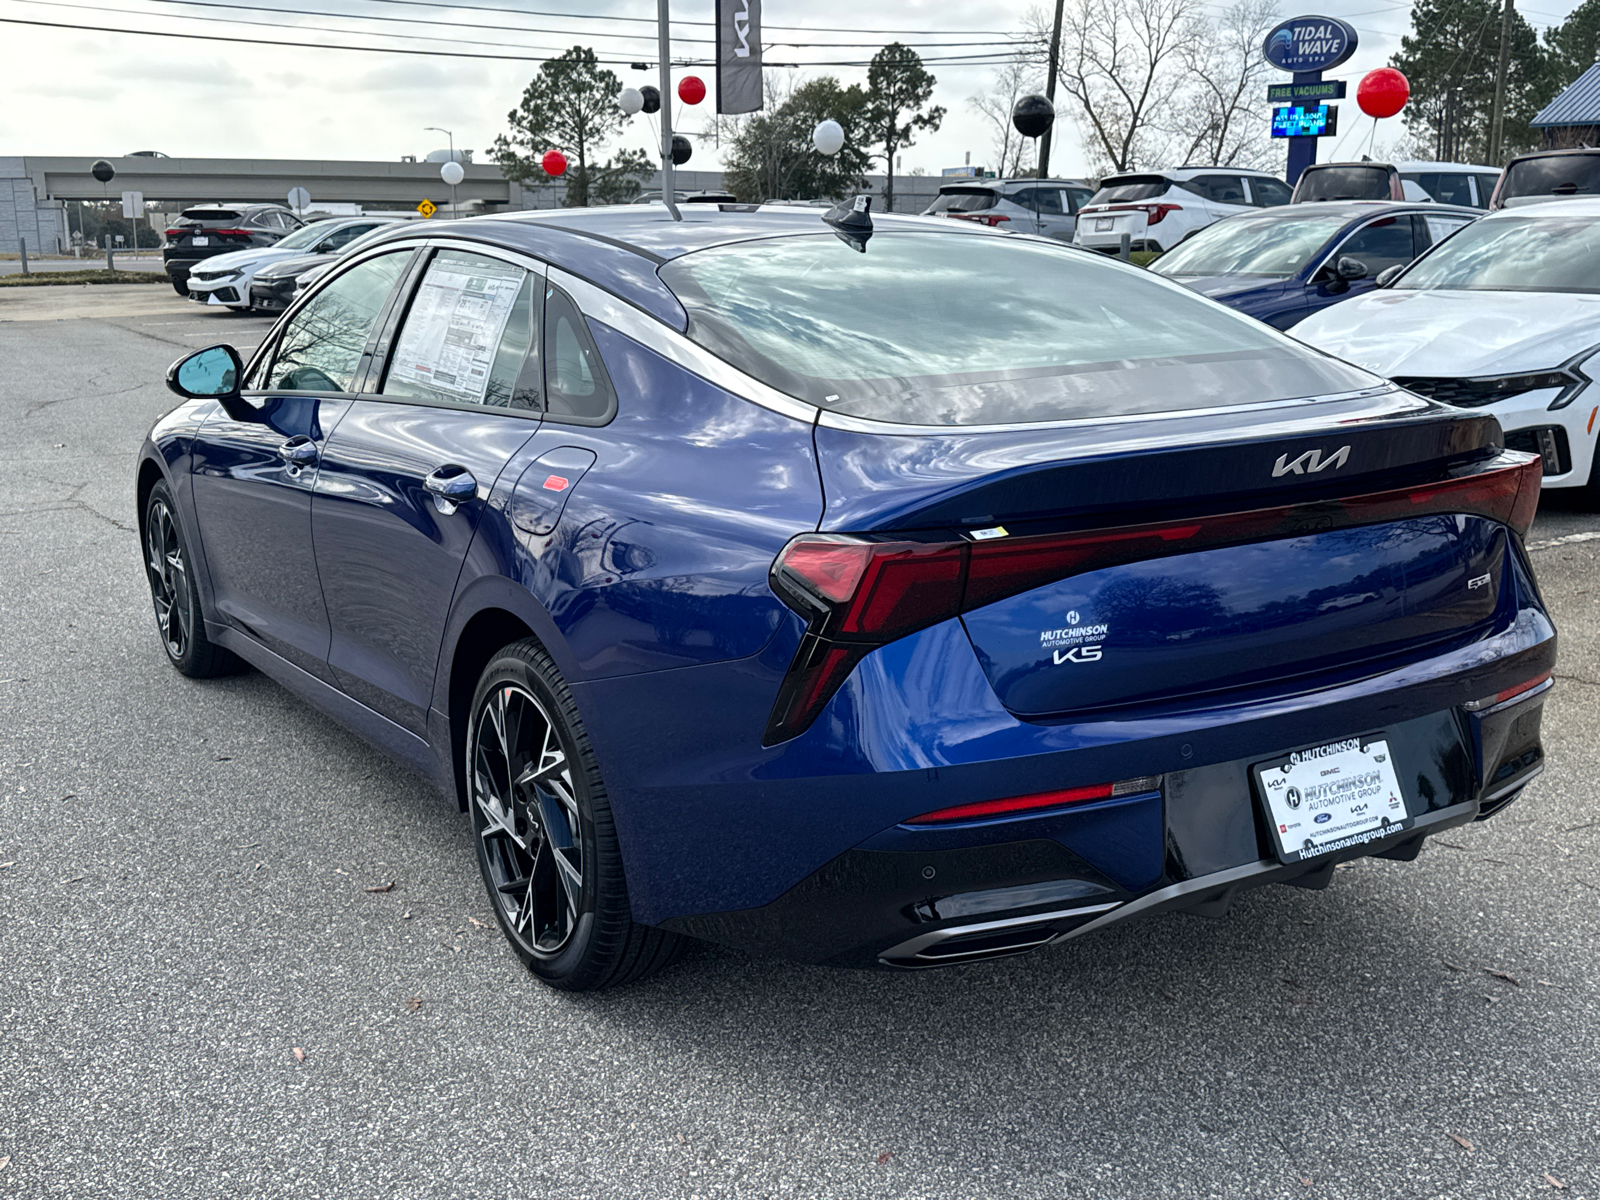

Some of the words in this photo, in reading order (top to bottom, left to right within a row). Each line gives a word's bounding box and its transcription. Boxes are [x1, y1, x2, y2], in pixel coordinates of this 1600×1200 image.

[1293, 25, 1332, 41] TIDAL
[1298, 39, 1340, 55] WAVE
[1270, 87, 1292, 98] FREE
[1294, 84, 1334, 96] VACUUMS
[1271, 445, 1351, 478] KIA
[1040, 624, 1108, 641] HUTCHINSON
[1042, 637, 1083, 648] AUTOMOTIVE
[1084, 634, 1106, 643] GROUP
[1053, 645, 1103, 665] K5
[1302, 738, 1360, 761] HUTCHINSON
[1320, 767, 1340, 777] GMC
[1304, 770, 1382, 802] HUTCHINSON
[1308, 790, 1356, 811] AUTOMOTIVE
[1358, 785, 1382, 799] GROUP
[1309, 815, 1379, 838] HUTCHINSONAUTOGROUP.COM
[1315, 813, 1331, 823] Ford
[1299, 822, 1403, 860] Hutchinsonautogroup.com
